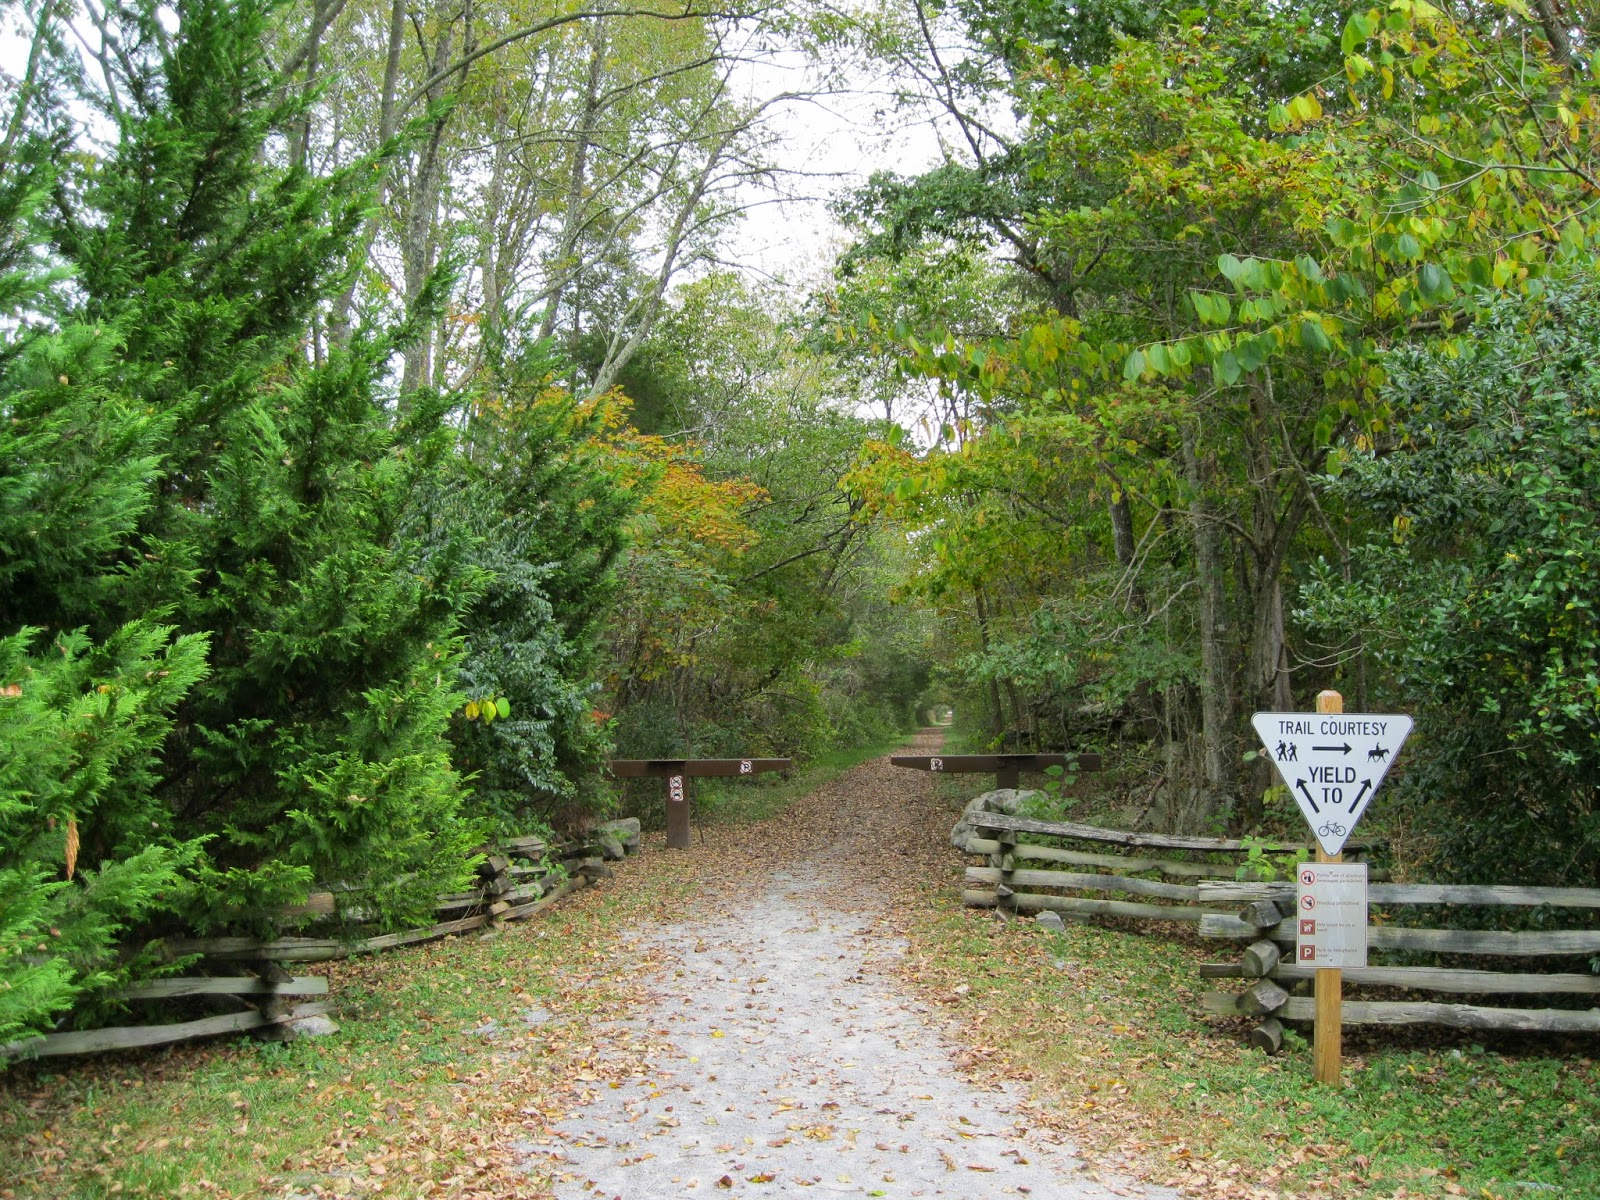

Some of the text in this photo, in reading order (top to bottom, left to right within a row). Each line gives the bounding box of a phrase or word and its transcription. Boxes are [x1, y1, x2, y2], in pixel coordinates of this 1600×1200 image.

[1278, 721, 1388, 736] TRAIL COURTESY
[1308, 767, 1356, 783] YIELD
[1321, 788, 1343, 804] TO
[1304, 947, 1312, 958] P
